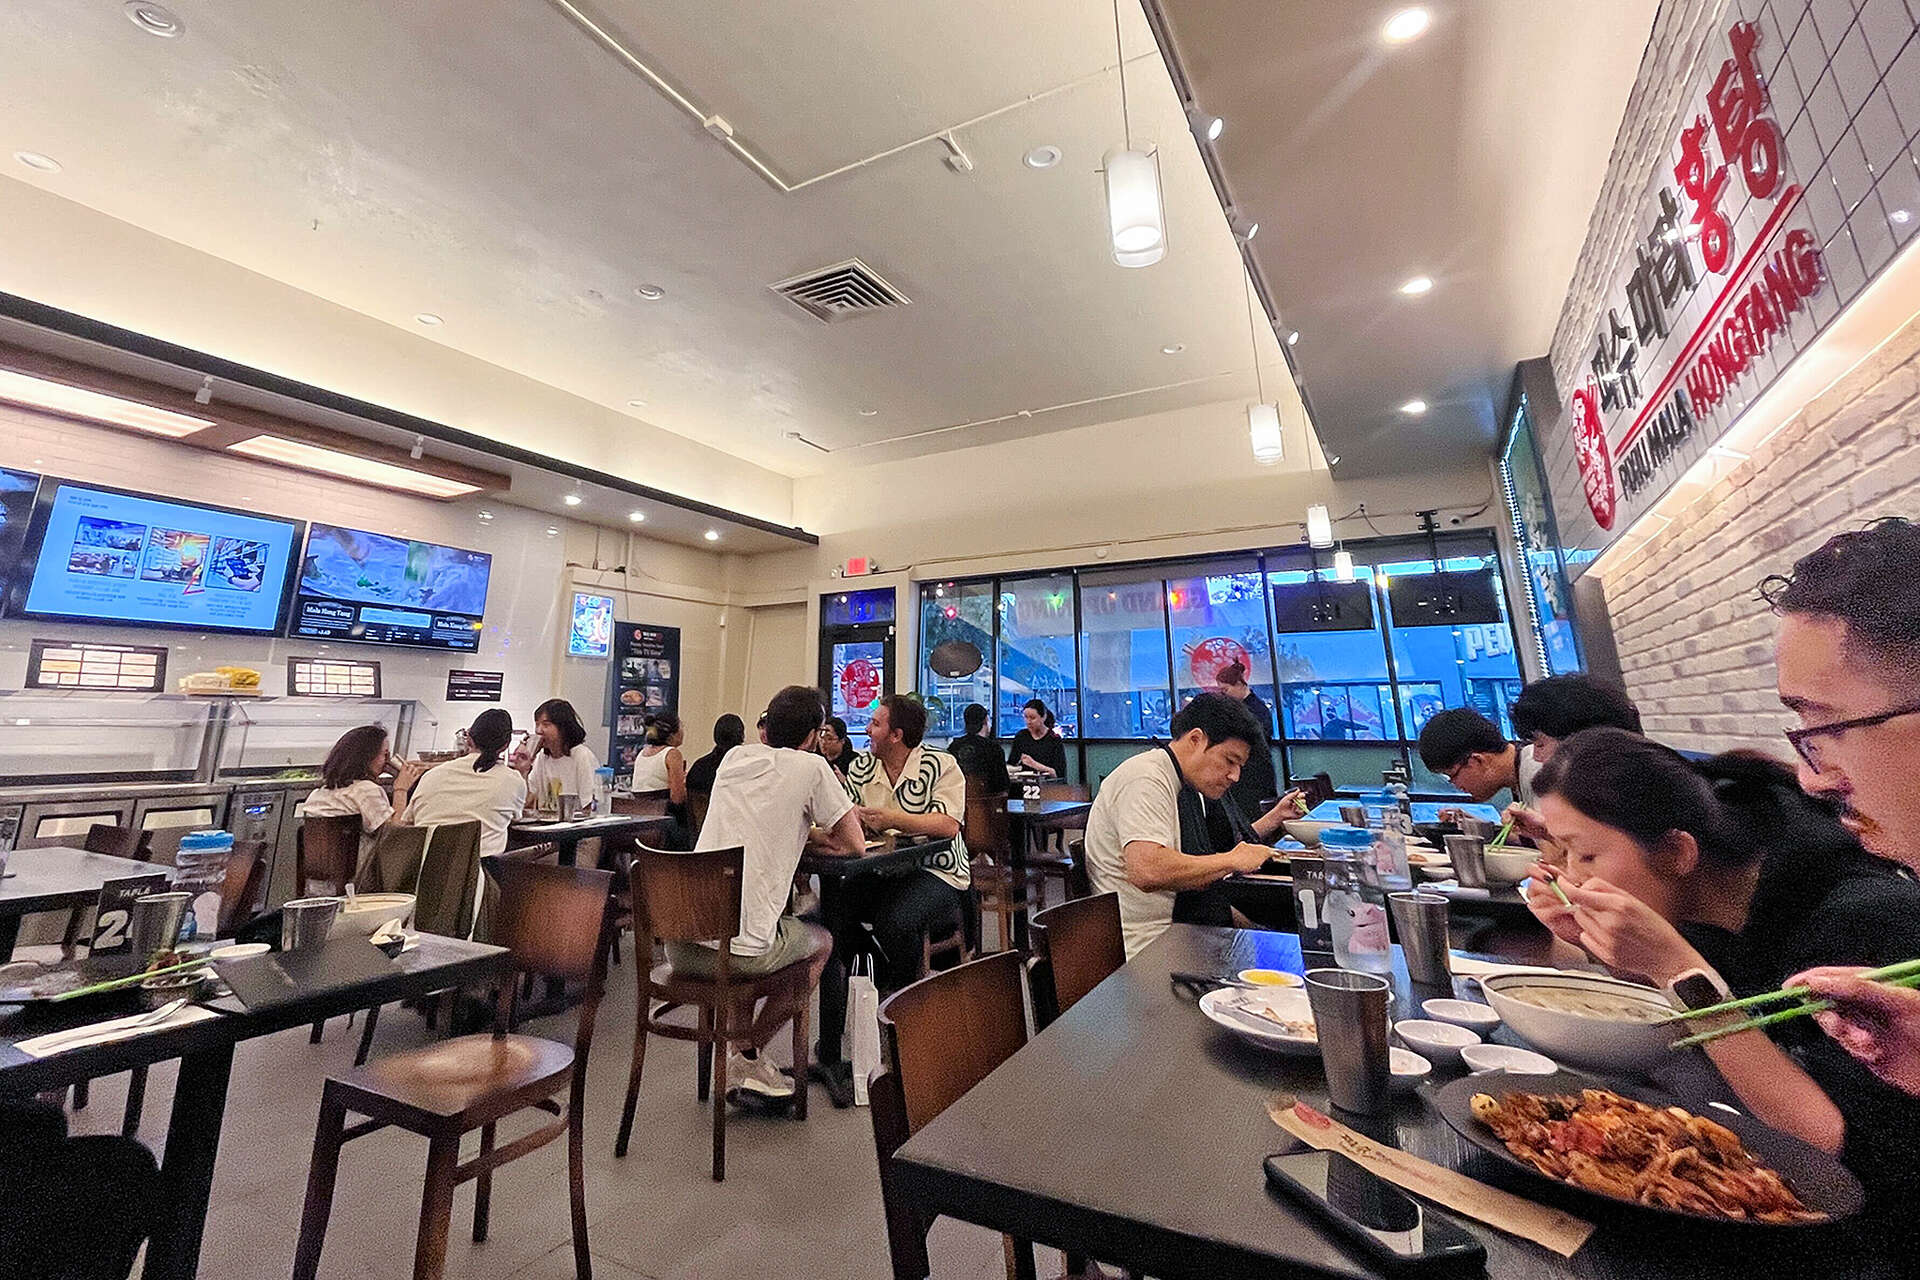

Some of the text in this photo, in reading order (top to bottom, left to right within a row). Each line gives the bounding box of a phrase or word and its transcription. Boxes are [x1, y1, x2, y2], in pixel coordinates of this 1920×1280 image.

[1646, 388, 1698, 468] MALA
[1686, 229, 1824, 421] HONGTANG
[1023, 785, 1040, 800] 22
